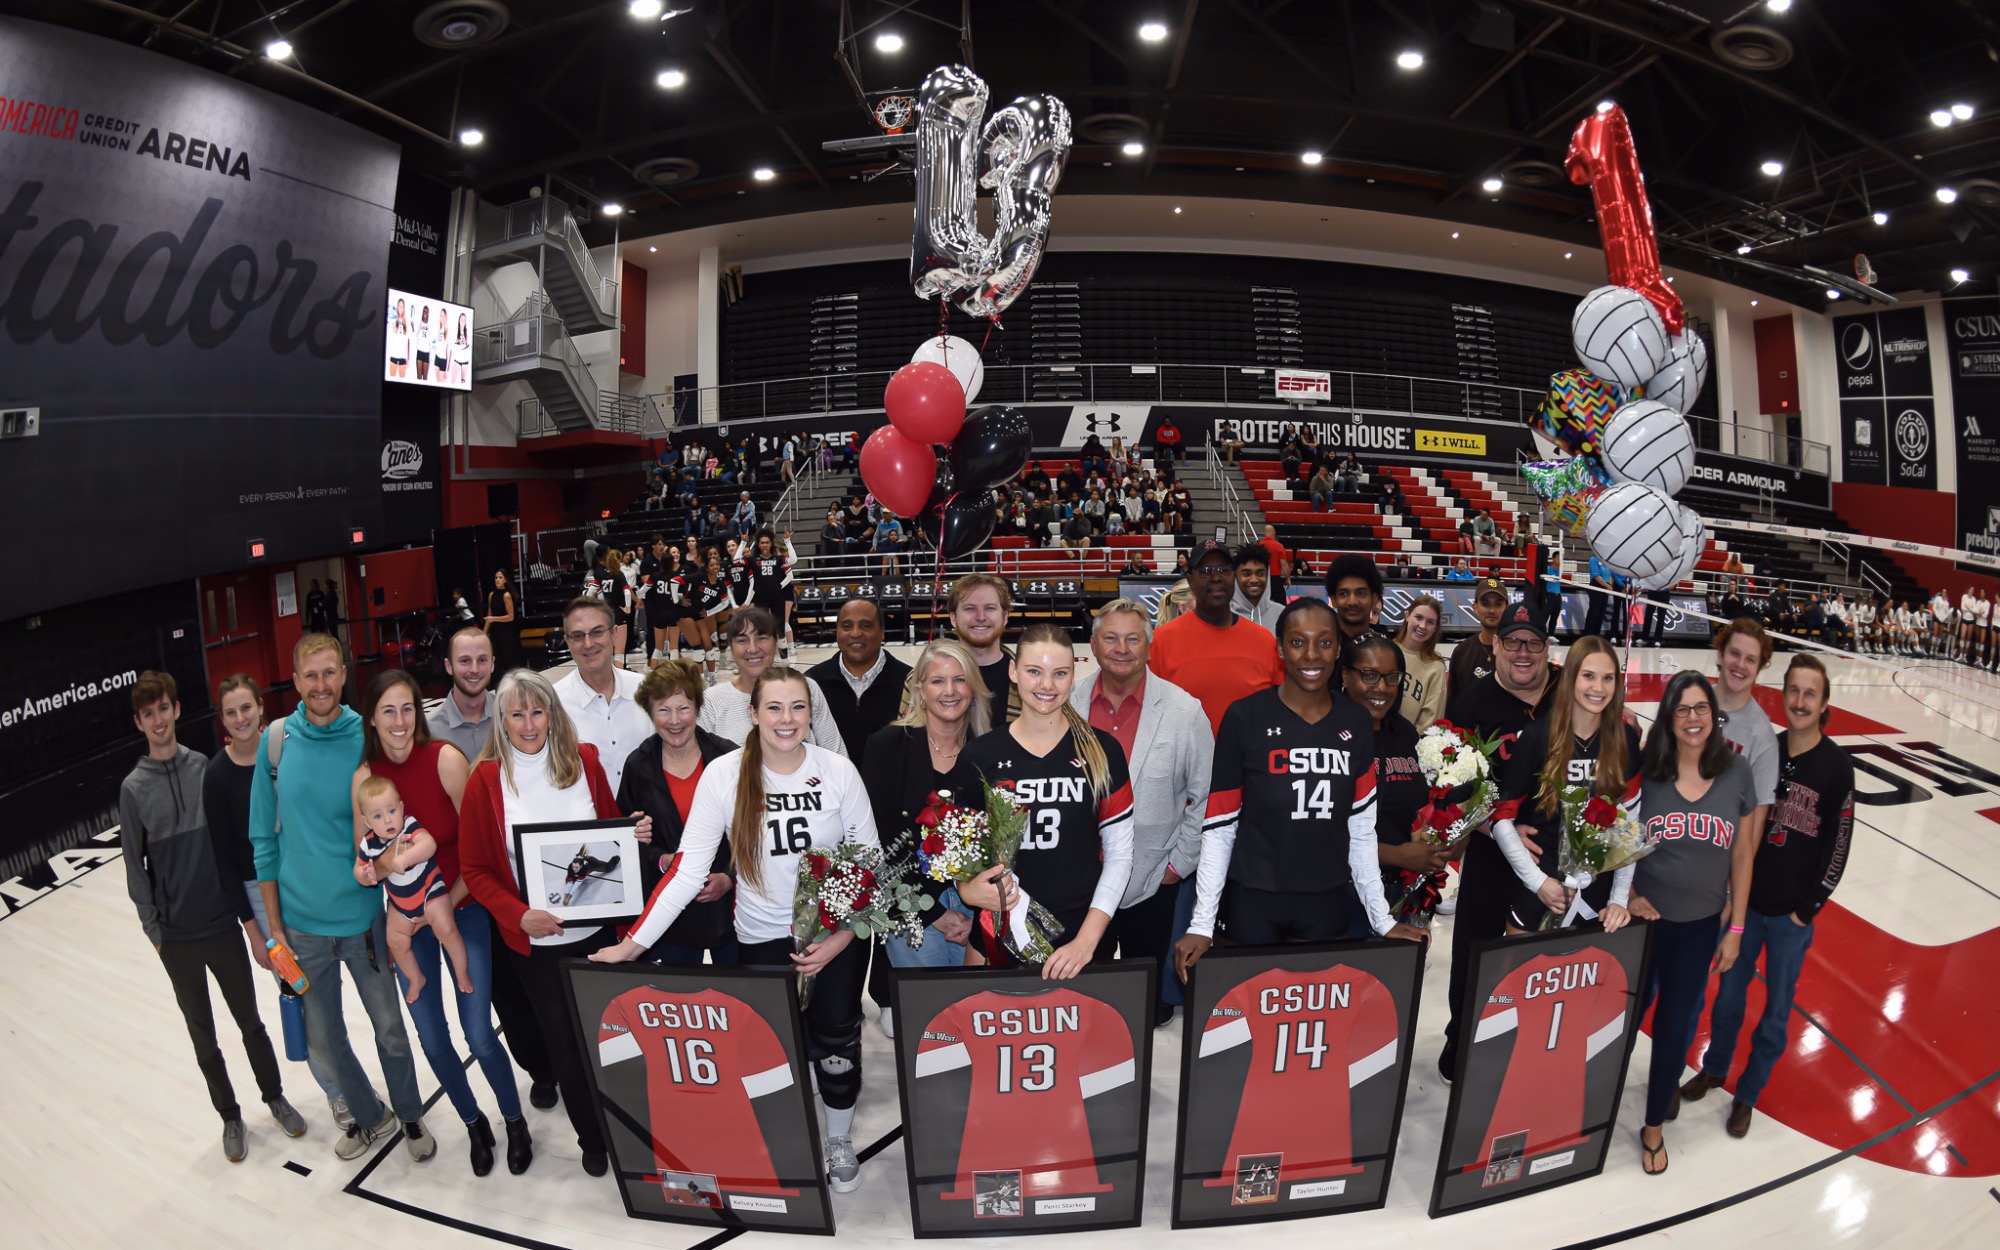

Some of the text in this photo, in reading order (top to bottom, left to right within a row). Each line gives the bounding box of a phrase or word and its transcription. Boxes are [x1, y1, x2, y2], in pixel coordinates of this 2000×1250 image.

[84, 114, 140, 136] CREDIT
[80, 130, 130, 151] UNION
[136, 128, 251, 182] ARENA
[397, 215, 439, 244] Mid-Valley
[396, 232, 437, 255] Dental Care
[0, 181, 376, 360] tadors
[1884, 341, 1927, 353] NUTRISHOP
[1974, 354, 2000, 364] STUDEN
[1974, 363, 2000, 372] HOUSIN
[1278, 377, 1329, 393] ESPN
[1848, 374, 1874, 389] pepsi
[1968, 453, 2000, 462] WOODLAND
[1690, 465, 1723, 481] DER
[1900, 462, 1926, 478] SoCal
[240, 493, 264, 504] EVERY
[266, 491, 296, 501] PERSON
[306, 488, 327, 498] EVERY
[329, 487, 347, 496] PATH
[732, 573, 741, 582] 10
[761, 566, 773, 576] 28
[601, 579, 614, 593] 27
[1683, 601, 1701, 612] THE
[0, 669, 138, 728] erAmerica.com
[1268, 748, 1350, 775] CSUN
[1567, 759, 1600, 781] SU
[765, 791, 822, 813] SUN
[1290, 779, 1334, 820] 14
[768, 817, 812, 856] 16
[1645, 812, 1734, 849] CSUN
[1524, 961, 1599, 1000] CSUN
[1259, 981, 1351, 1015] CSUN
[637, 1002, 729, 1032] CSUN
[972, 1005, 1079, 1036] CSUN
[1545, 1000, 1565, 1052] 1
[1272, 1019, 1329, 1073] 14
[664, 1036, 719, 1086] 16
[997, 1043, 1056, 1093] 13
[1297, 1185, 1339, 1196] Taylor Hunter
[733, 1199, 754, 1207] Kelsey
[1043, 1200, 1087, 1211] Perri Starkey
